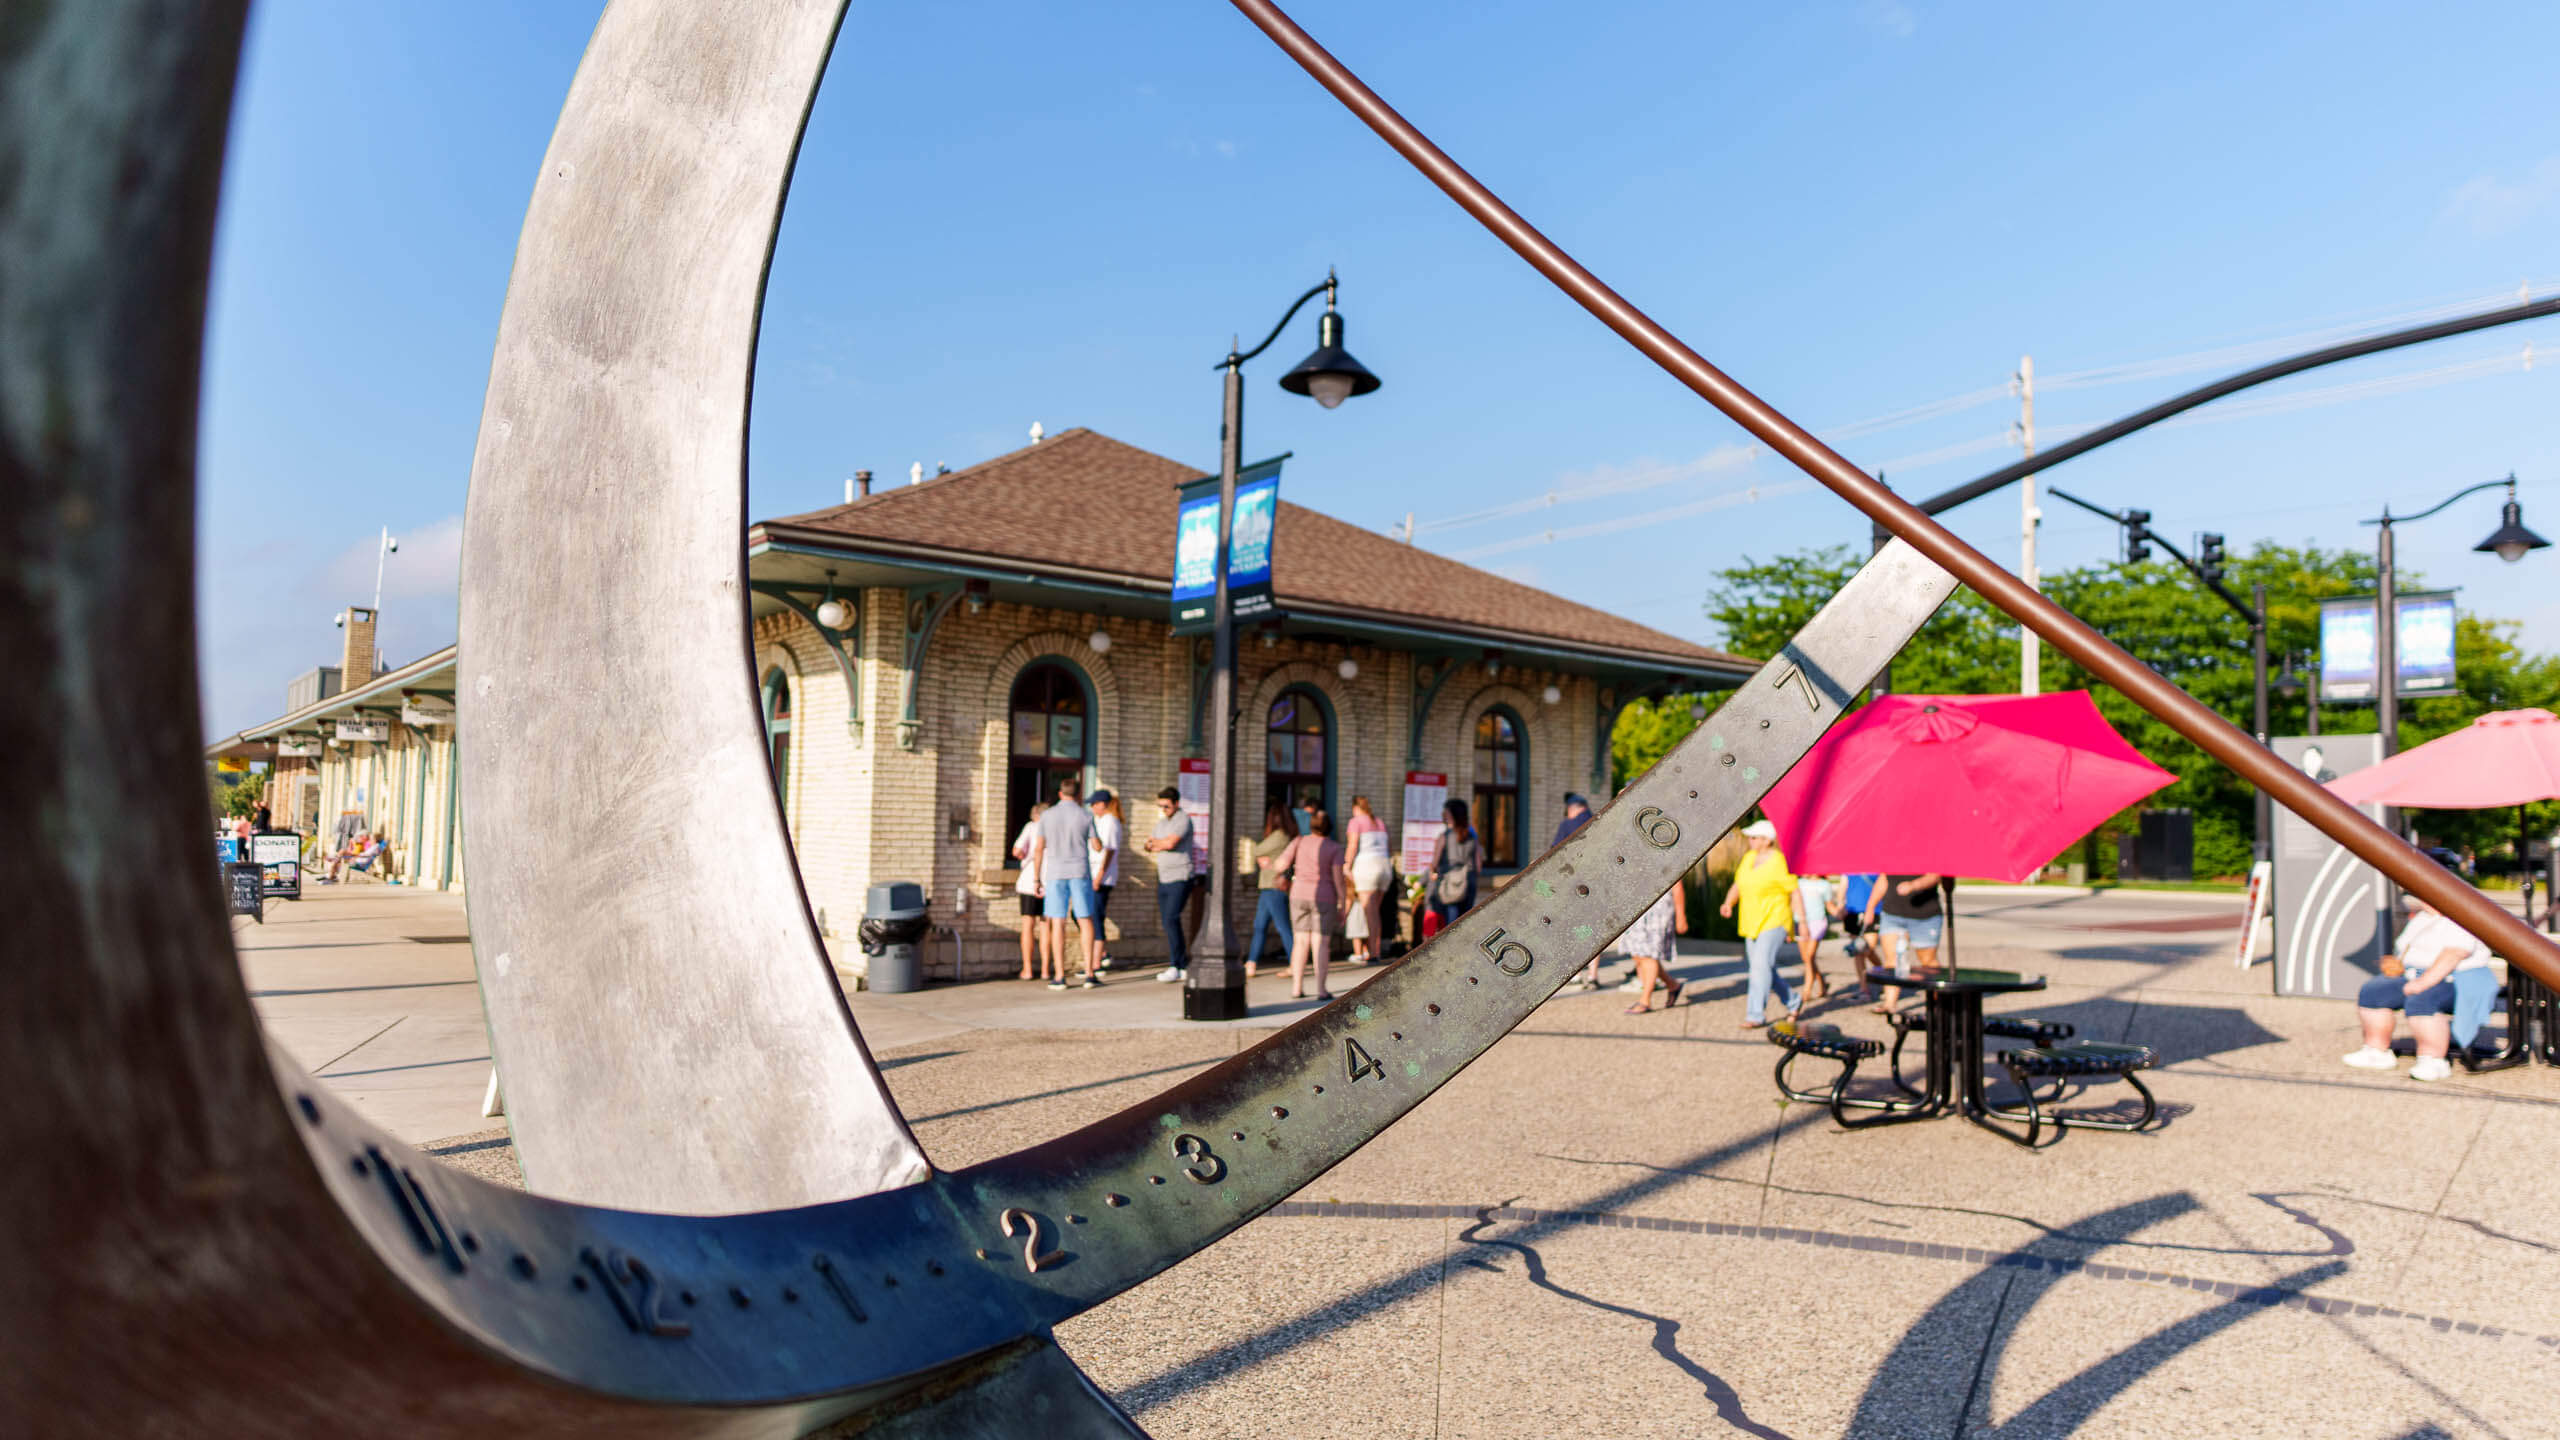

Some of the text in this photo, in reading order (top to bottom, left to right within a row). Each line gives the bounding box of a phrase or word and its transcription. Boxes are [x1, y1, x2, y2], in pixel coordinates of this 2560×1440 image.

[1773, 662, 1819, 711] 7
[1632, 805, 1680, 850] 6
[1478, 927, 1533, 978] 5
[1344, 1037, 1386, 1083] 4
[1170, 1133, 1222, 1185] 3
[1000, 1207, 1066, 1273] 2
[578, 1244, 692, 1337] 12
[813, 1252, 868, 1324] 1
